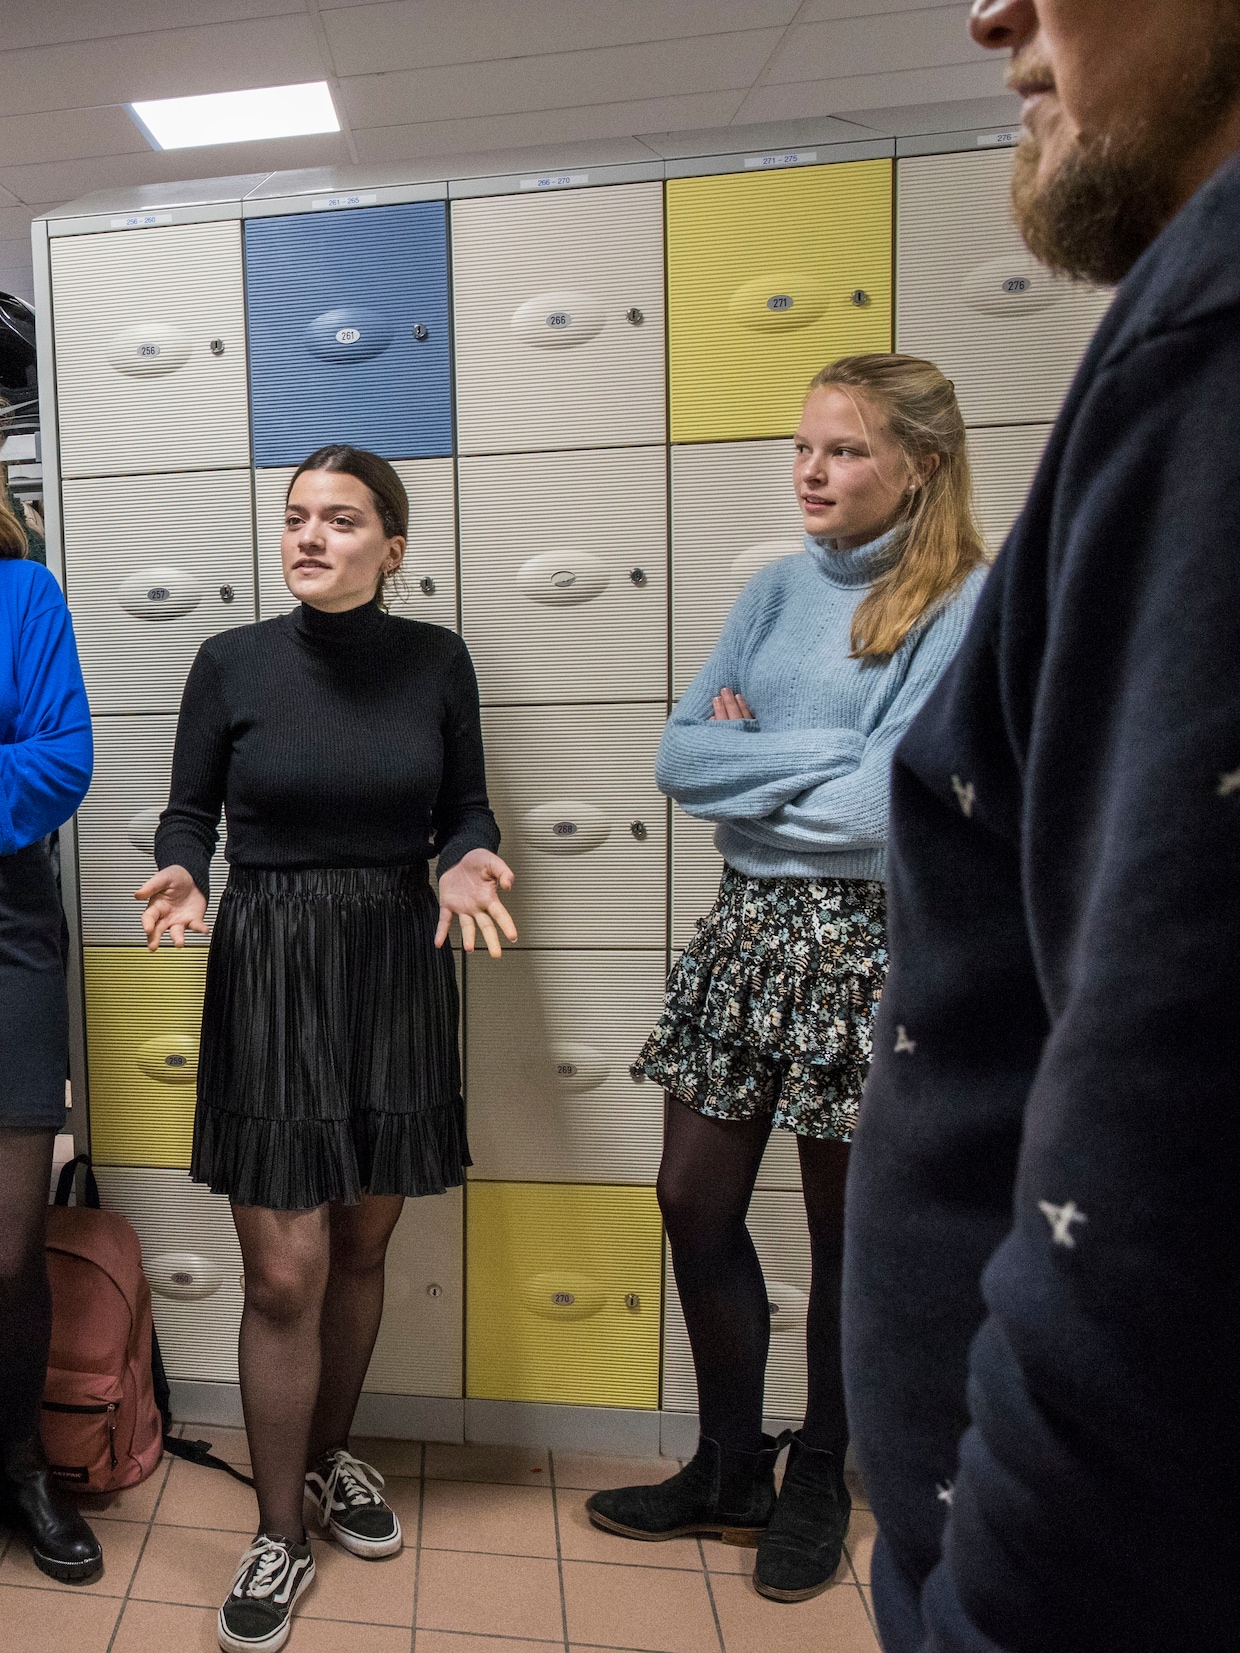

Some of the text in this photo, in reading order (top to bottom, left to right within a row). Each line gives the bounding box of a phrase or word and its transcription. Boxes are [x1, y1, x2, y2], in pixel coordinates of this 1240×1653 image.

[997, 134, 1012, 142] 276
[763, 157, 775, 165] 271
[784, 155, 798, 163] 275
[537, 179, 550, 187] 266
[557, 177, 570, 185] 270
[347, 197, 360, 205] 265
[144, 216, 156, 224] 260
[1008, 281, 1024, 291] 276
[773, 298, 787, 307] 271
[550, 316, 565, 325] 266
[341, 331, 354, 340] 261
[141, 347, 155, 355] 256
[151, 590, 165, 599] 257
[558, 826, 573, 834] 268
[557, 1066, 571, 1074] 269
[175, 1275, 188, 1283] 260
